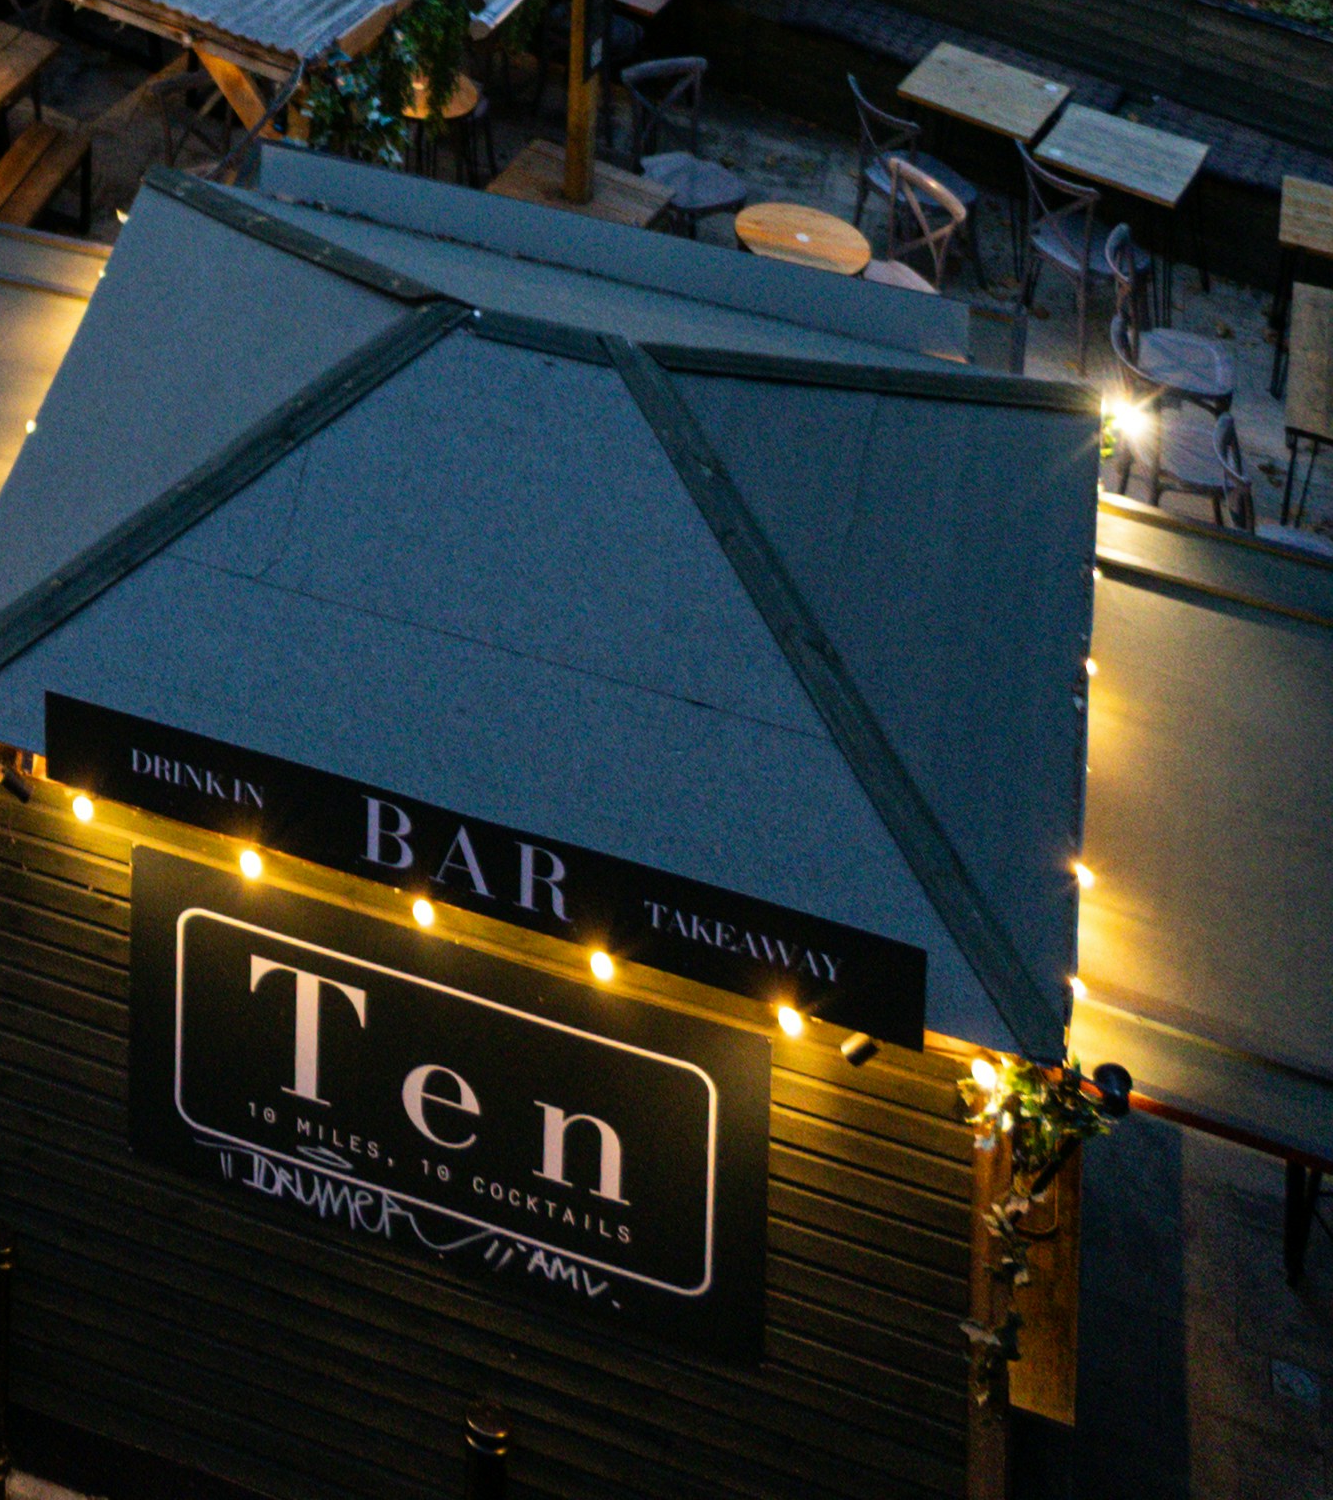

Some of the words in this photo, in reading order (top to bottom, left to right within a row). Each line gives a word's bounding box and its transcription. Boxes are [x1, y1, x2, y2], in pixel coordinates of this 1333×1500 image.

[132, 748, 225, 800] DRINK
[234, 781, 266, 809] IN
[362, 794, 574, 923] BAR
[644, 900, 843, 983] TAKEAWAY
[250, 954, 630, 1206] Ten
[248, 1101, 277, 1125] 10
[296, 1118, 396, 1168] MILES,
[421, 1158, 451, 1183] 10
[472, 1175, 632, 1245] COCKTAILS
